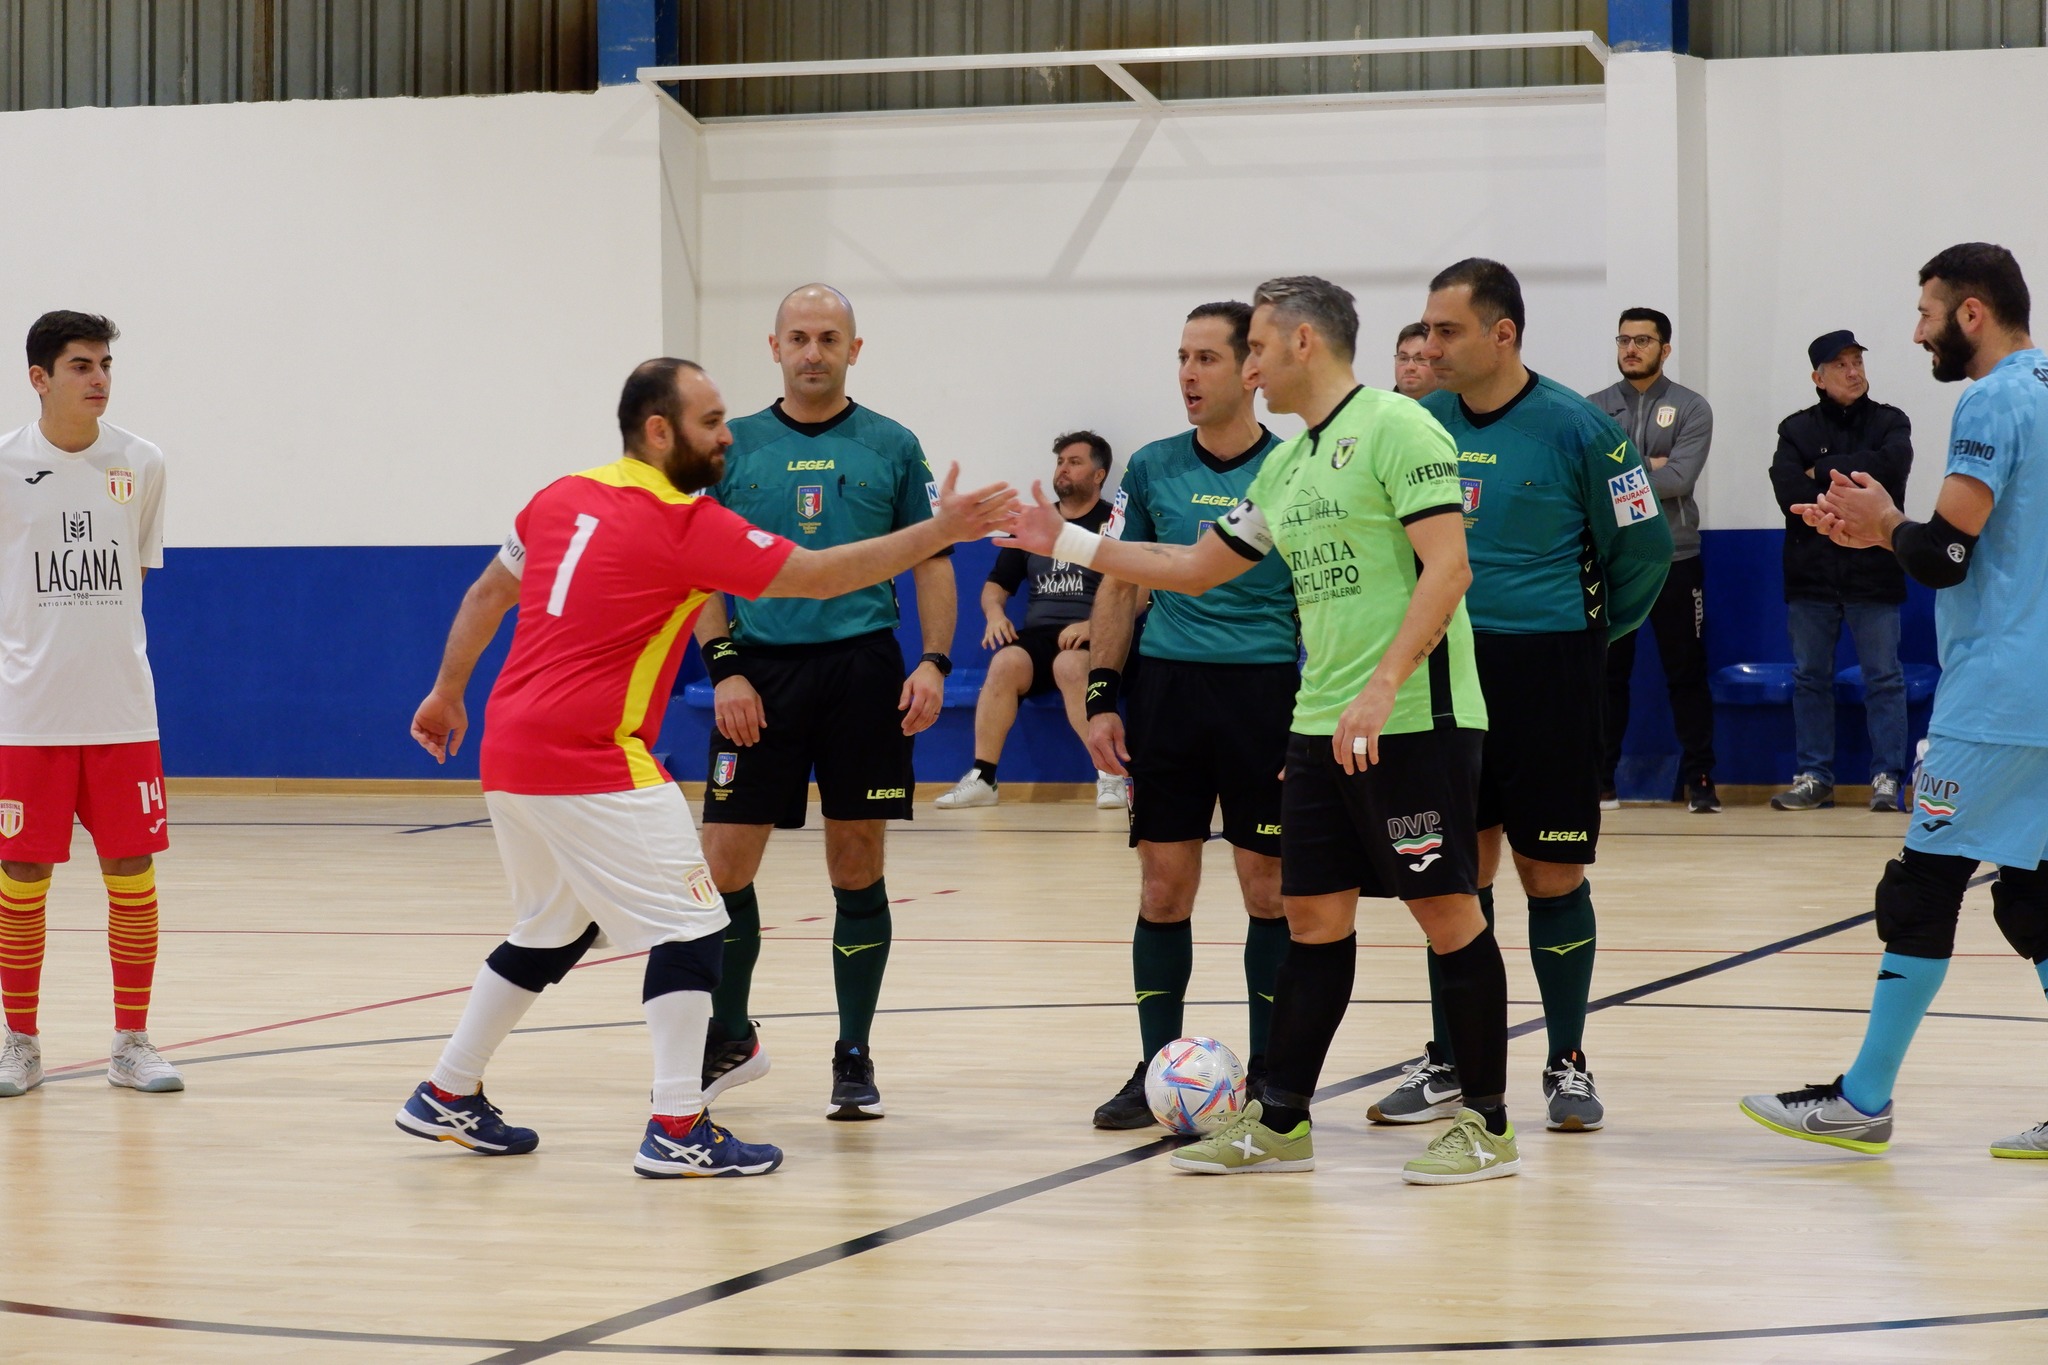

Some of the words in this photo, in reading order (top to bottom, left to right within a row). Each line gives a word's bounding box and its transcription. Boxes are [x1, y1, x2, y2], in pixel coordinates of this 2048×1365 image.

[109, 470, 132, 478] MESSINA
[787, 459, 835, 471] LEGEA
[1611, 468, 1646, 496] NET
[1615, 485, 1650, 504] INSURANCE
[1191, 493, 1238, 508] LEGEA
[34, 539, 123, 593] LAGANÀ
[546, 512, 600, 617] 1
[138, 777, 164, 814] 14
[1920, 772, 1960, 800] DVP
[1386, 810, 1442, 840] DVP
[1538, 830, 1588, 842] LEGEA
